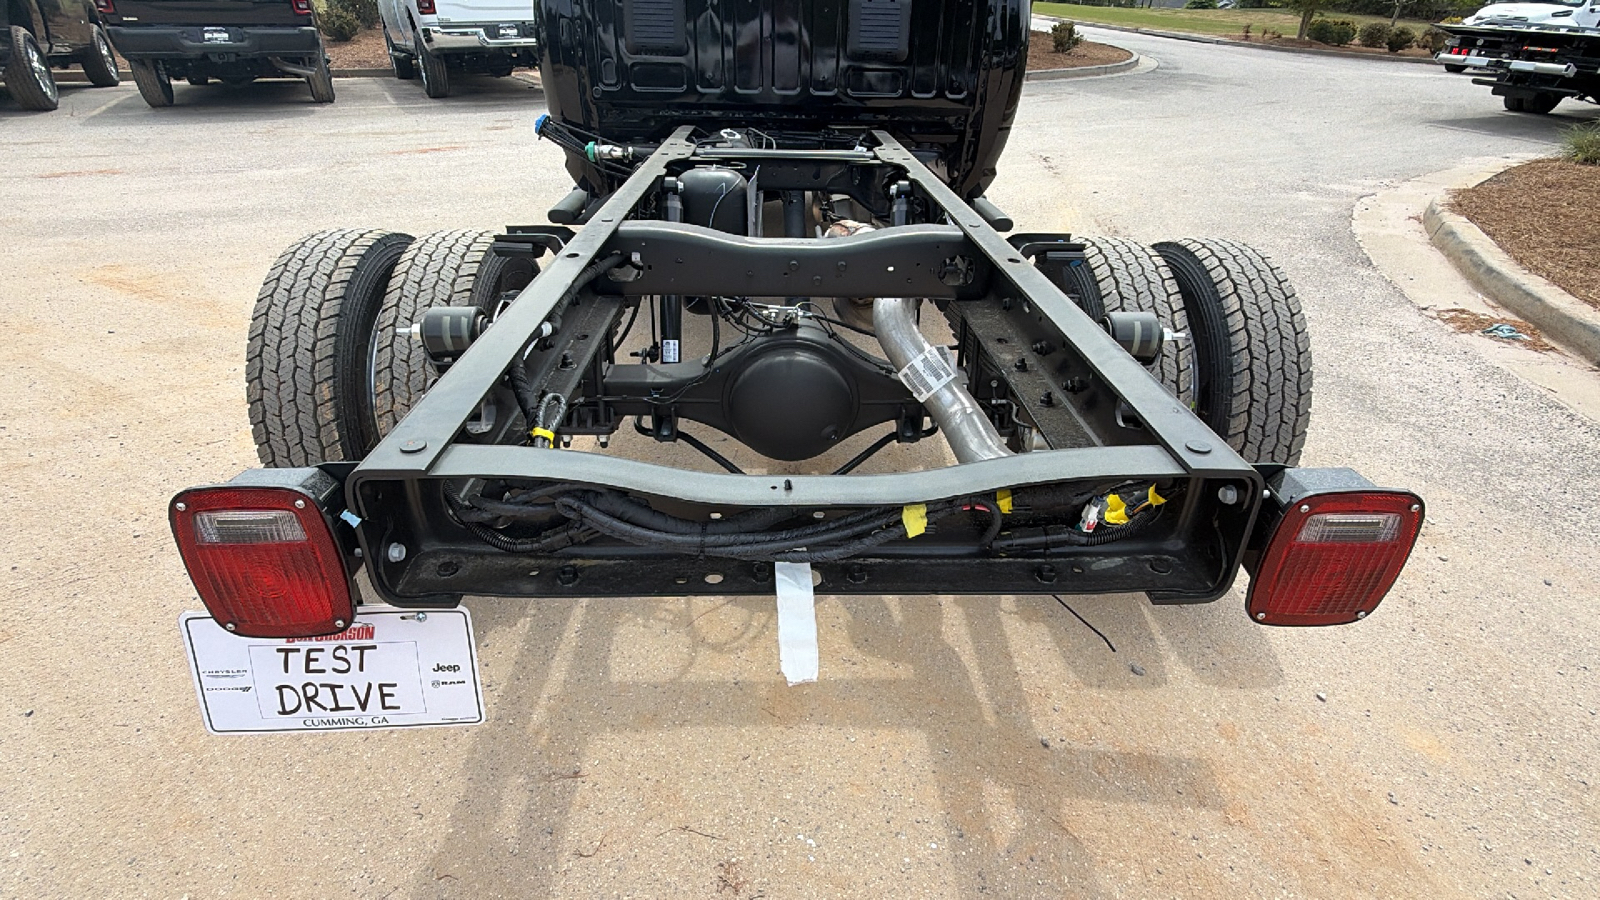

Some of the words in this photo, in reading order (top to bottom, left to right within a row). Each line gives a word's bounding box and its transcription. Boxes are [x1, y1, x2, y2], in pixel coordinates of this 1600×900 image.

[276, 645, 378, 674] TEST
[432, 662, 461, 673] Jeep
[276, 682, 401, 716] DRIVE
[302, 717, 368, 727] CUMMING,
[371, 716, 389, 724] GA
